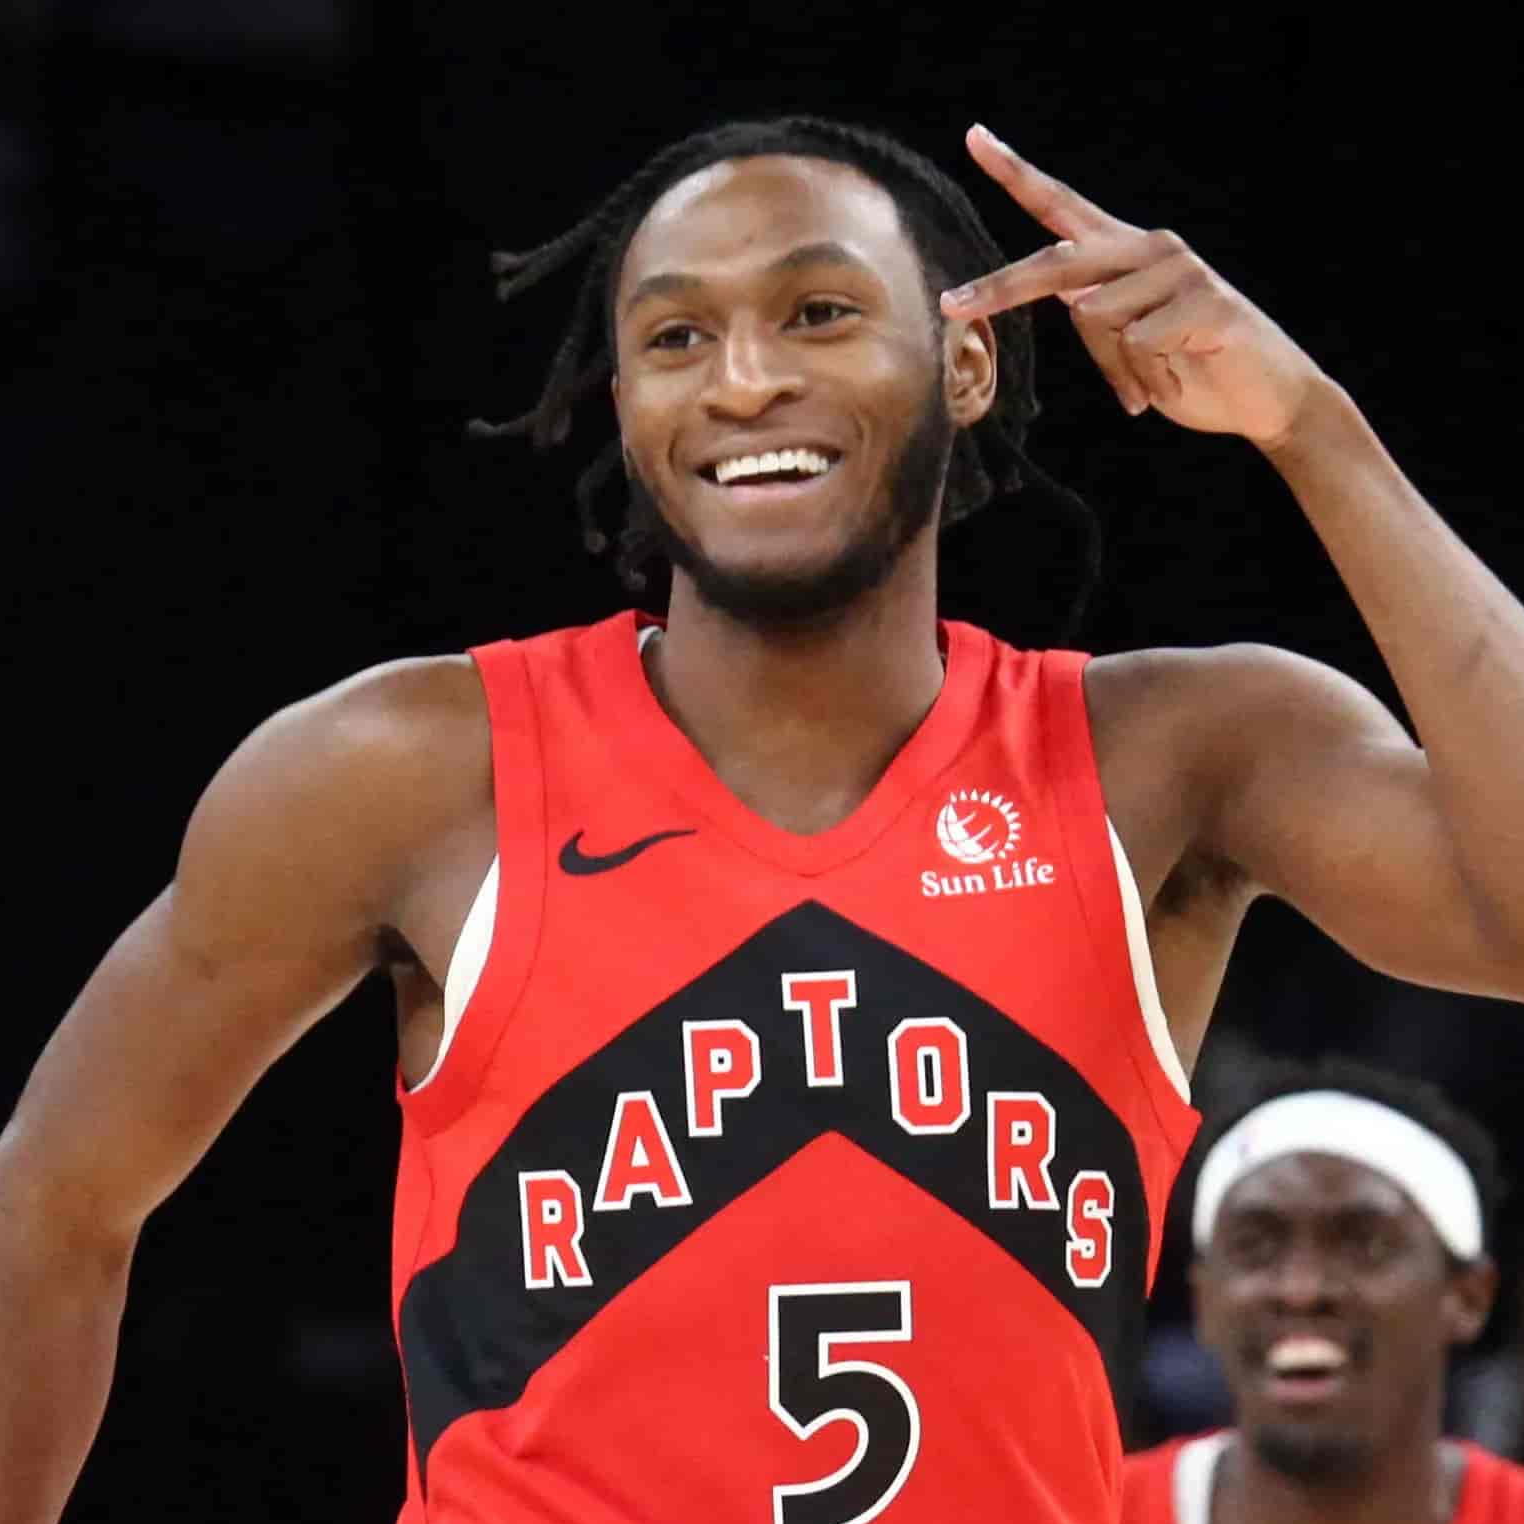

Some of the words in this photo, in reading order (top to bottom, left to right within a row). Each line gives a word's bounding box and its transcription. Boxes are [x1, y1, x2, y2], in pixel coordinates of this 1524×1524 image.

[920, 870, 986, 897] Sun
[992, 857, 1055, 890] Life
[518, 970, 1114, 1288] RAPTORS
